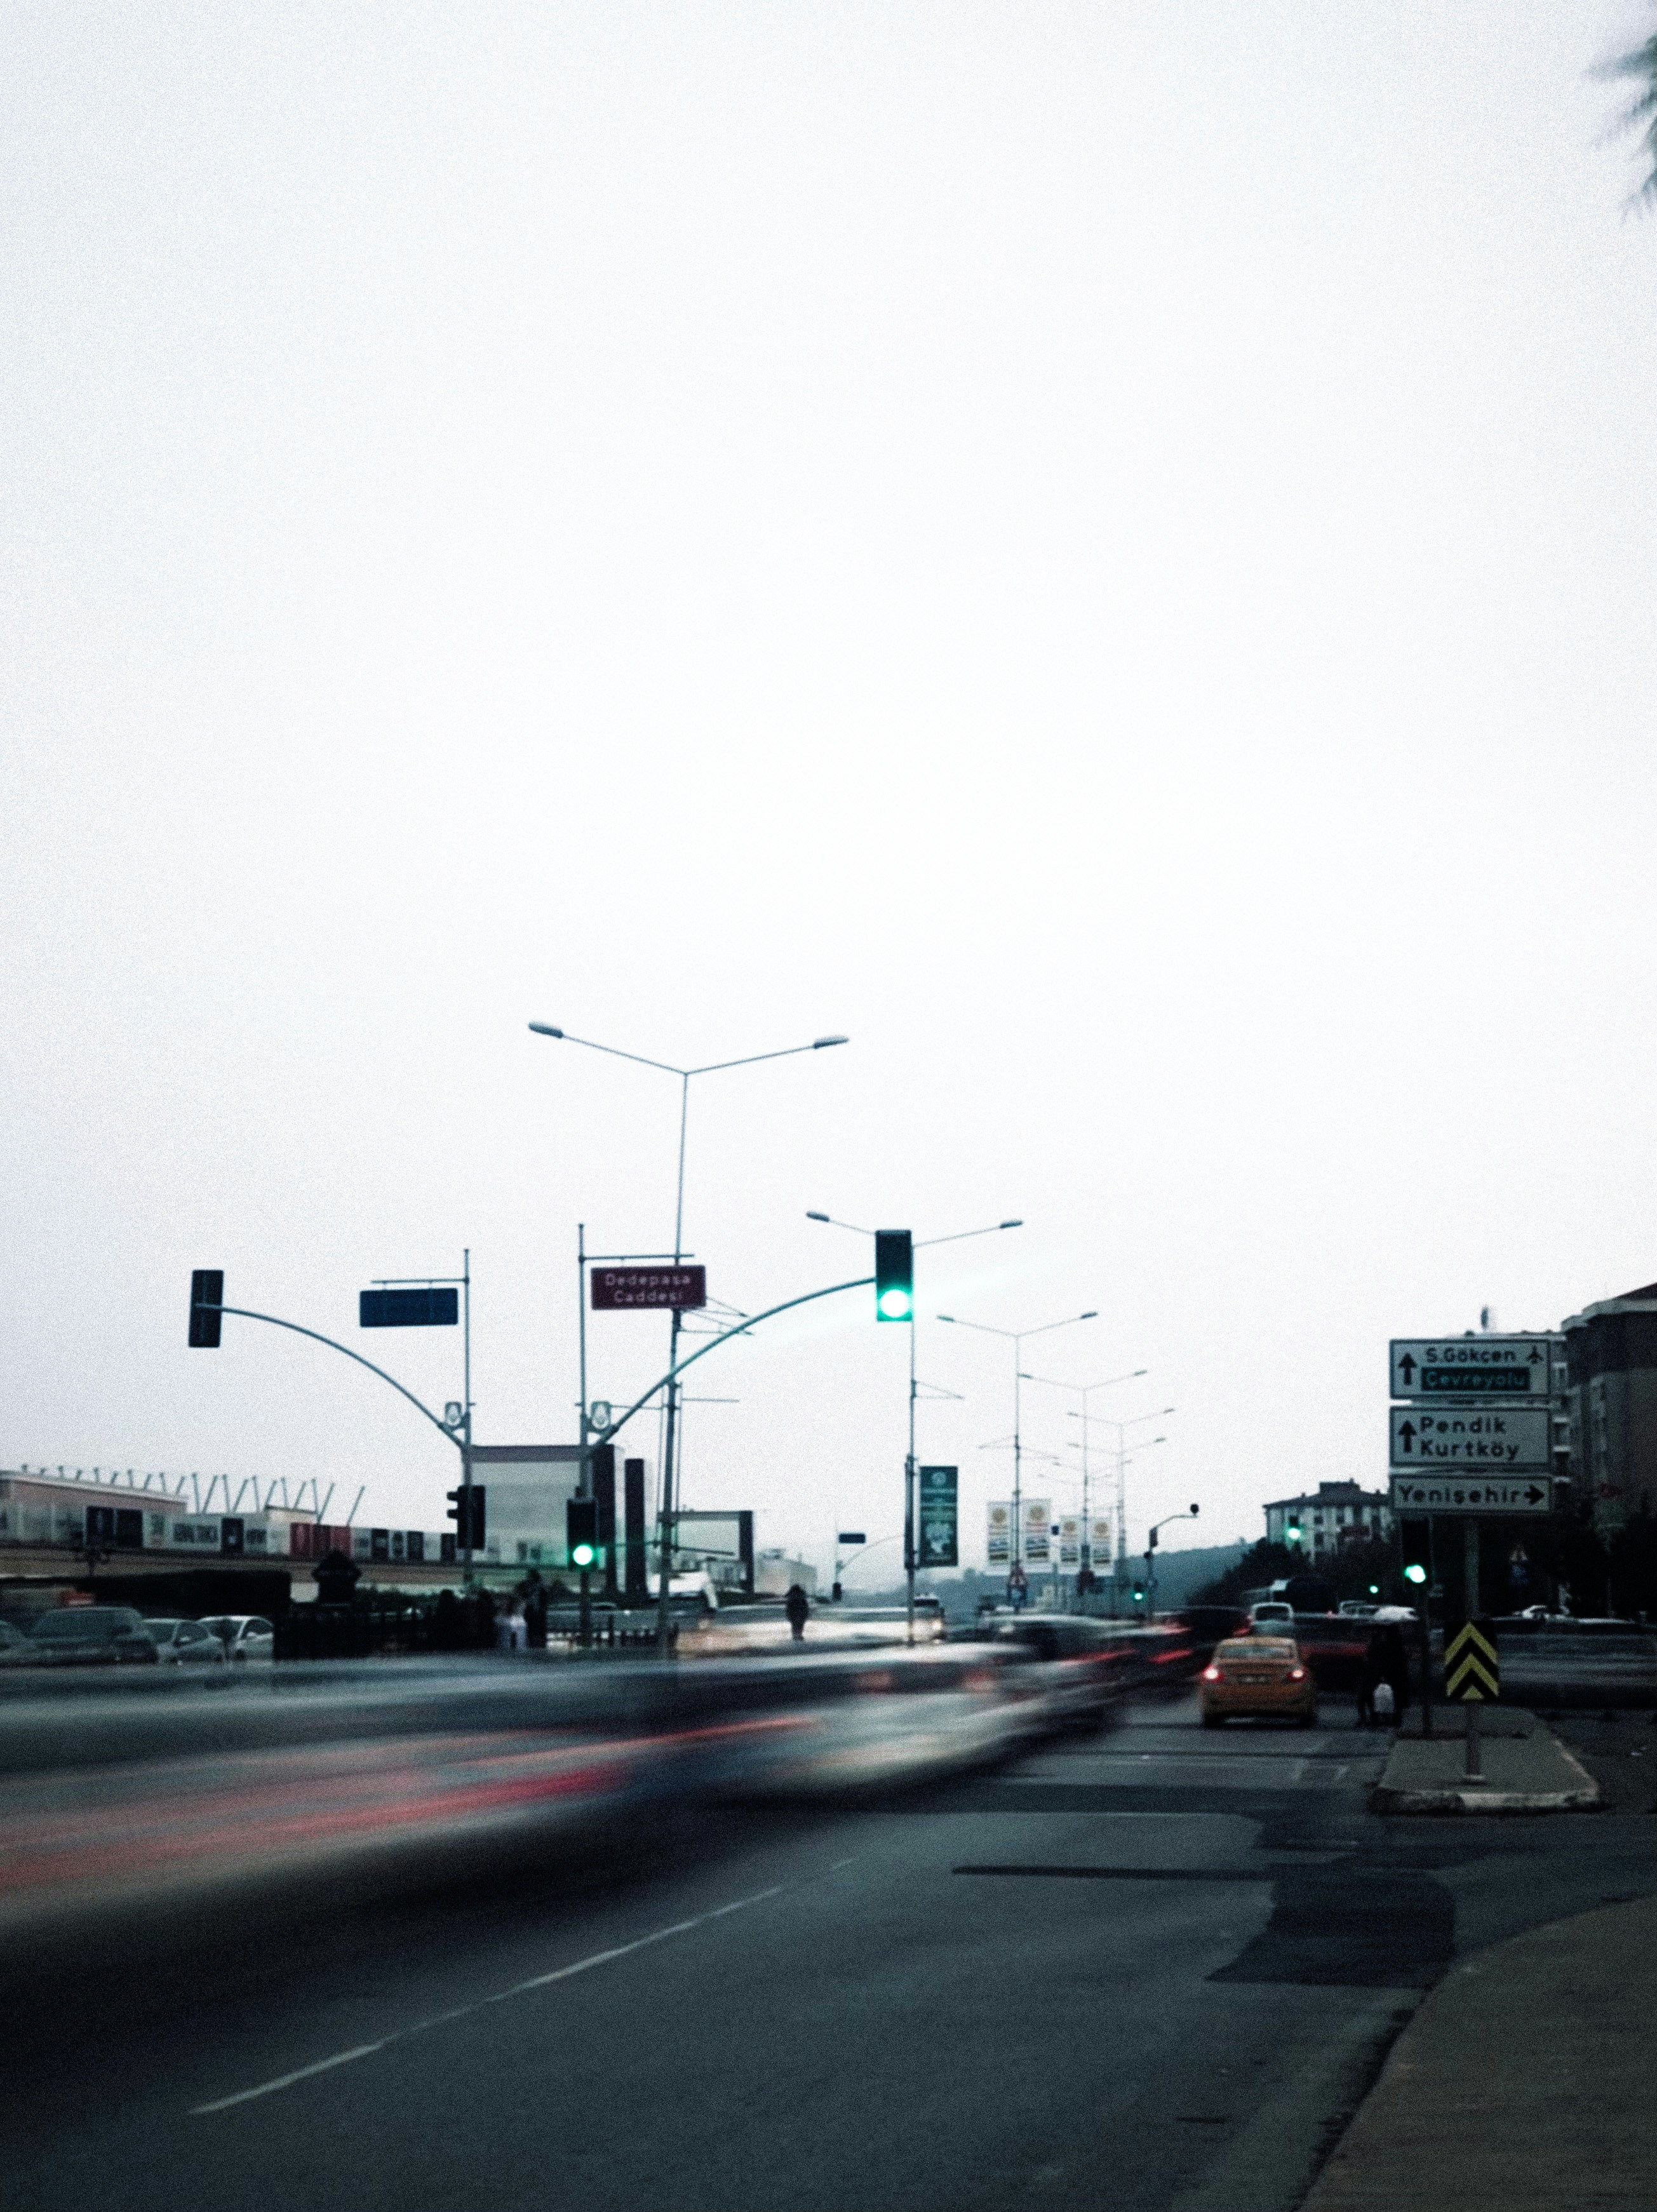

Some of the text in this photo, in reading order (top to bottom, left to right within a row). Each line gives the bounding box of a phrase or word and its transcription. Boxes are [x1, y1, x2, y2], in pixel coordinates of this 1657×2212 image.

[1419, 1416, 1507, 1433] Pendik
[1419, 1440, 1520, 1461] Kurtköy
[1399, 1484, 1520, 1505] Yenişehir
